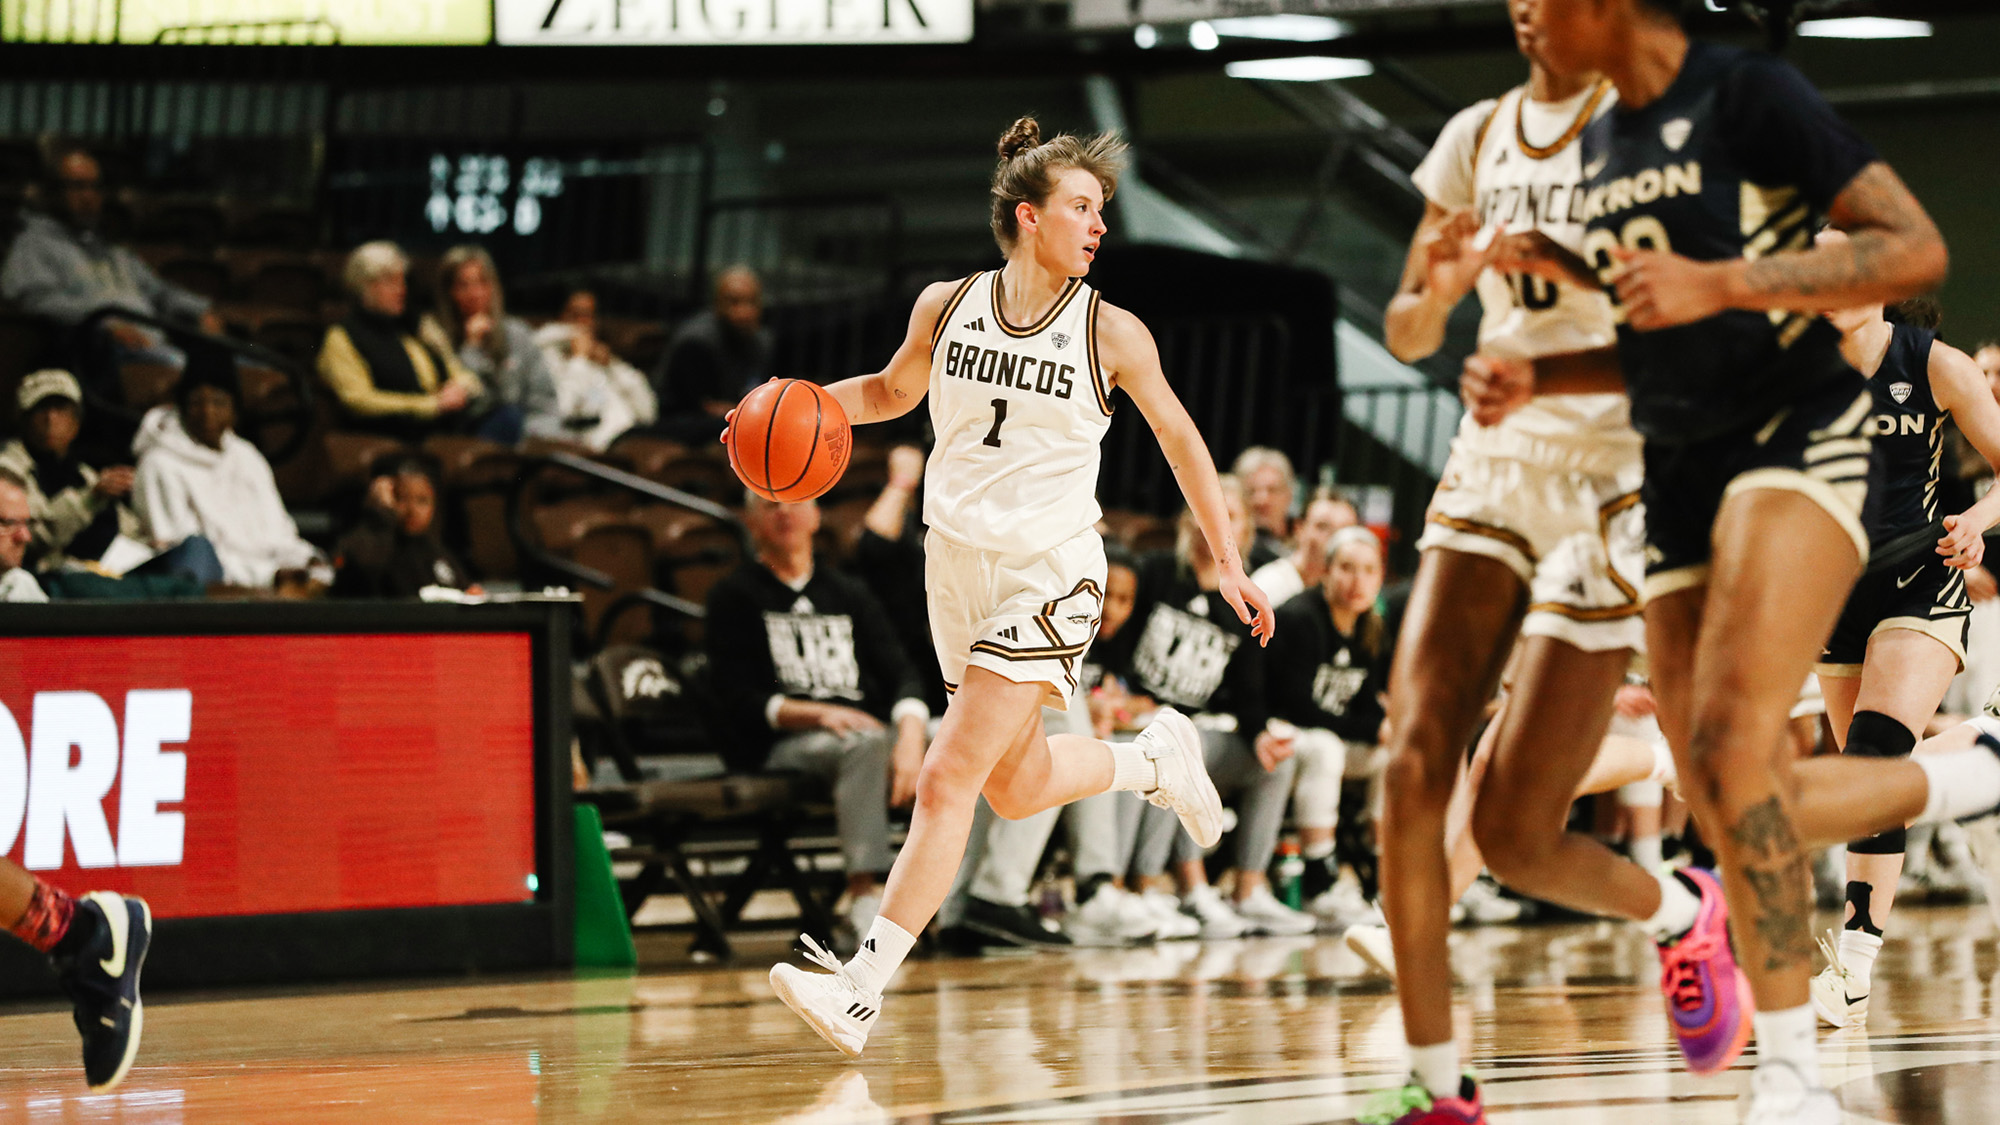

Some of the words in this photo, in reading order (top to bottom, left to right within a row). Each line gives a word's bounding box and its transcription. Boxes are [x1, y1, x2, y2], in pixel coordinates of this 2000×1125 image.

[1584, 160, 1702, 225] KRON
[946, 341, 1075, 400] BRONCOS
[832, 422, 846, 468] adidas
[983, 398, 1008, 448] 1
